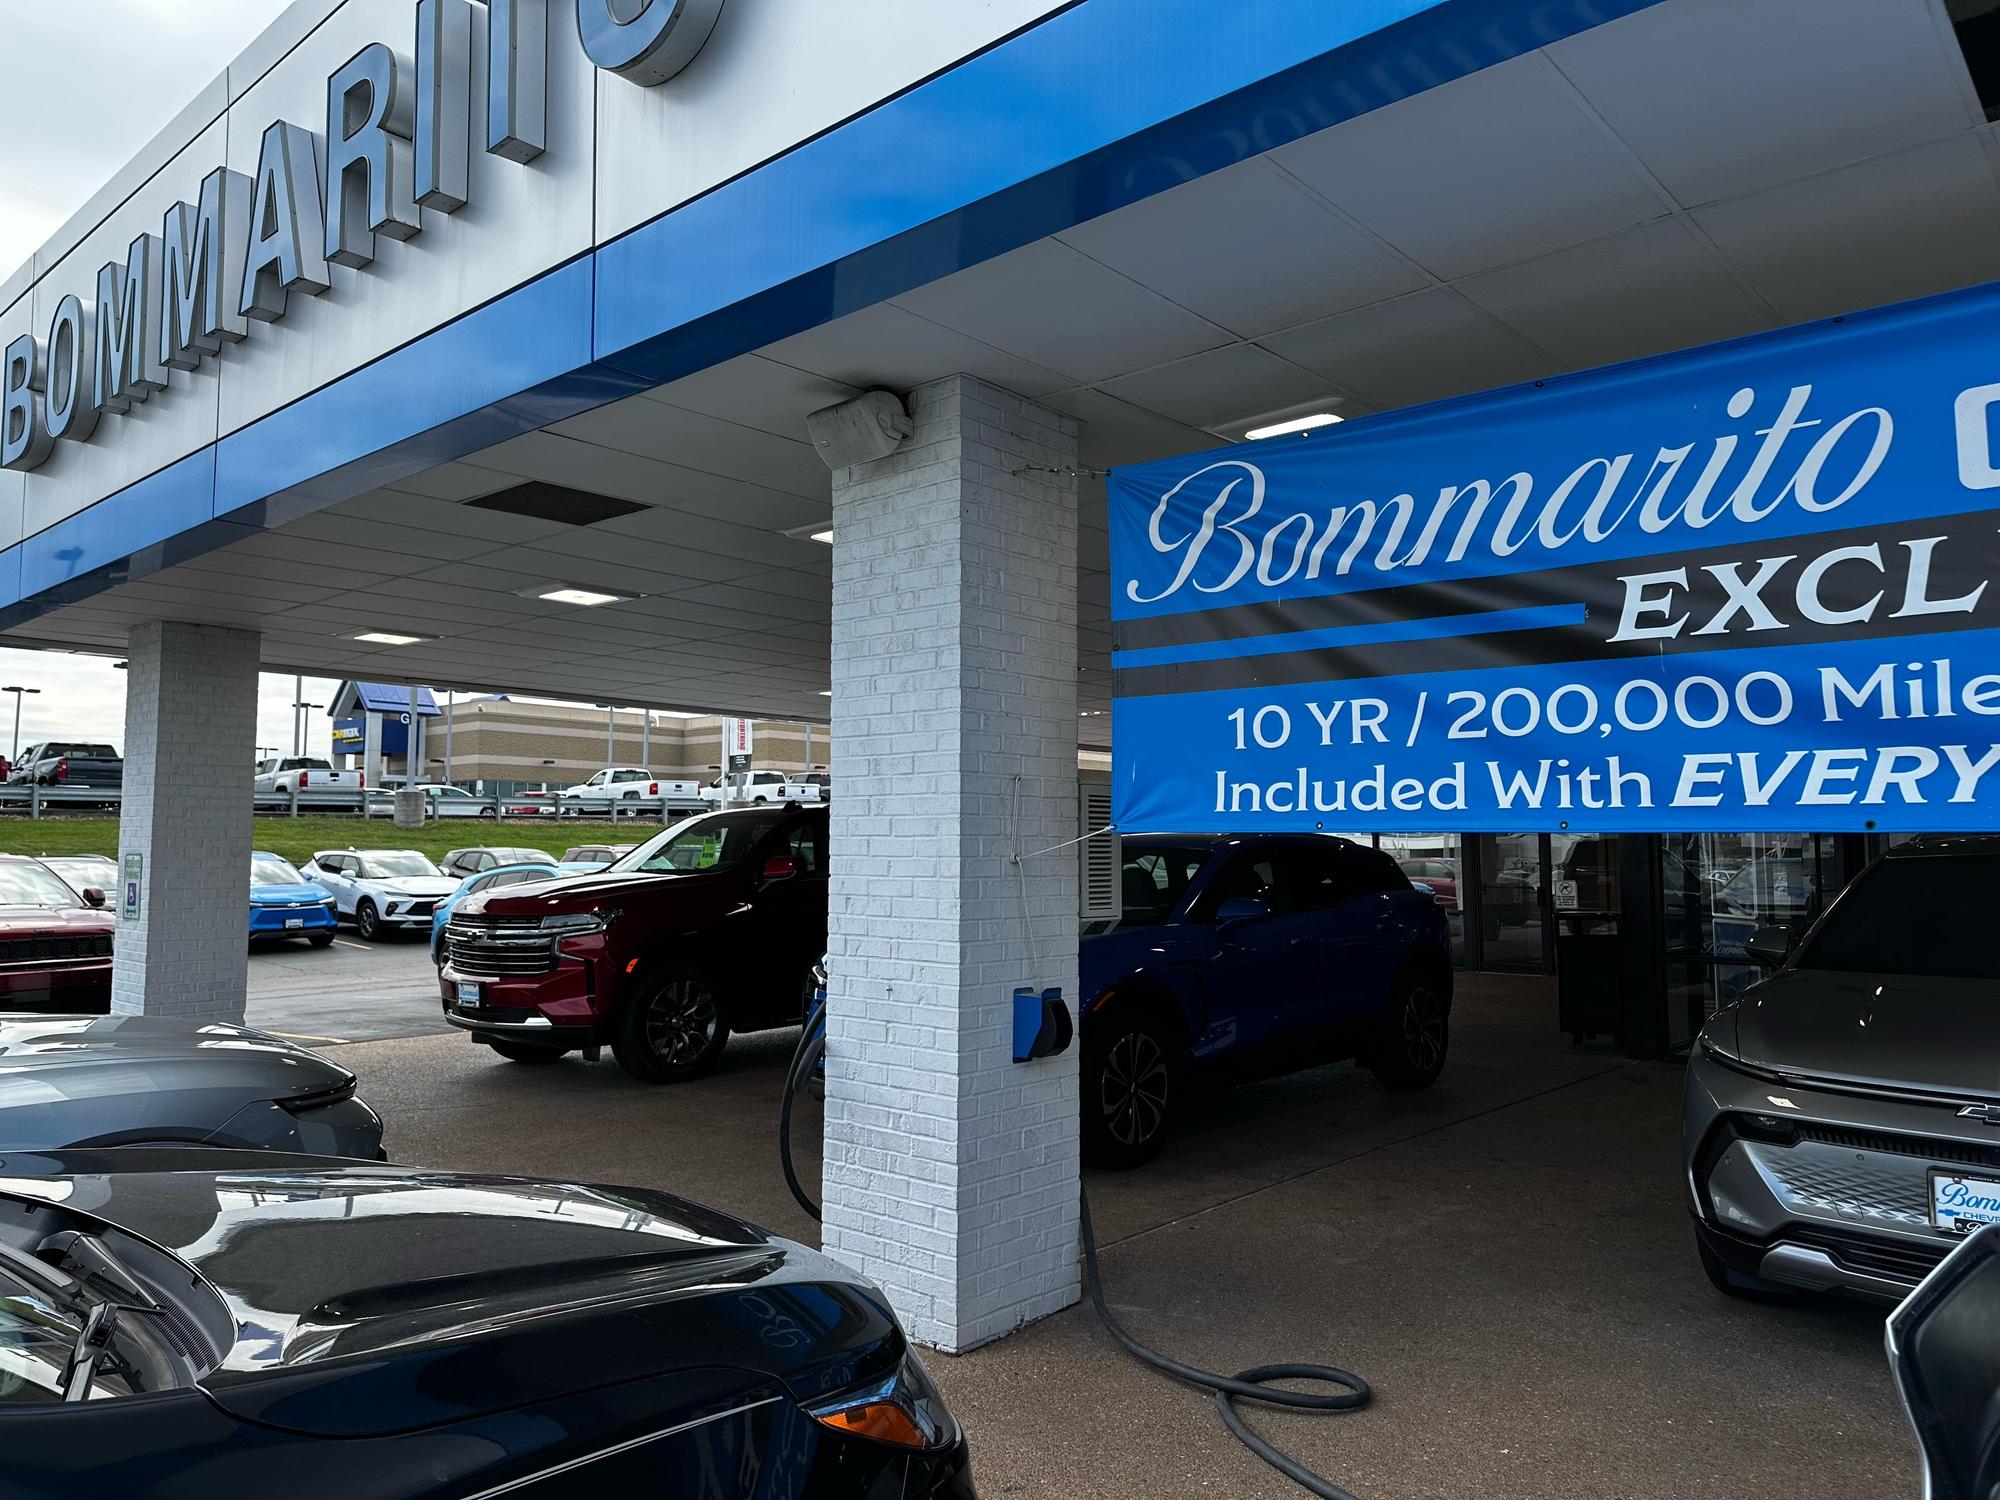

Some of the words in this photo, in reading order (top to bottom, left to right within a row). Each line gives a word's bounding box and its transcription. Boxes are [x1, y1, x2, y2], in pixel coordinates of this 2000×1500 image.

[1126, 384, 1894, 603] Bommarito
[1606, 535, 2000, 643] EXCL
[1227, 704, 1291, 750] 10
[1305, 697, 1390, 746] YR
[1406, 692, 1428, 747] /
[1447, 670, 1793, 739] 200,000
[1214, 762, 1468, 813] Included
[1485, 756, 1655, 810] With
[1668, 743, 2000, 807] EVERY
[1936, 1183, 2000, 1212] Bom
